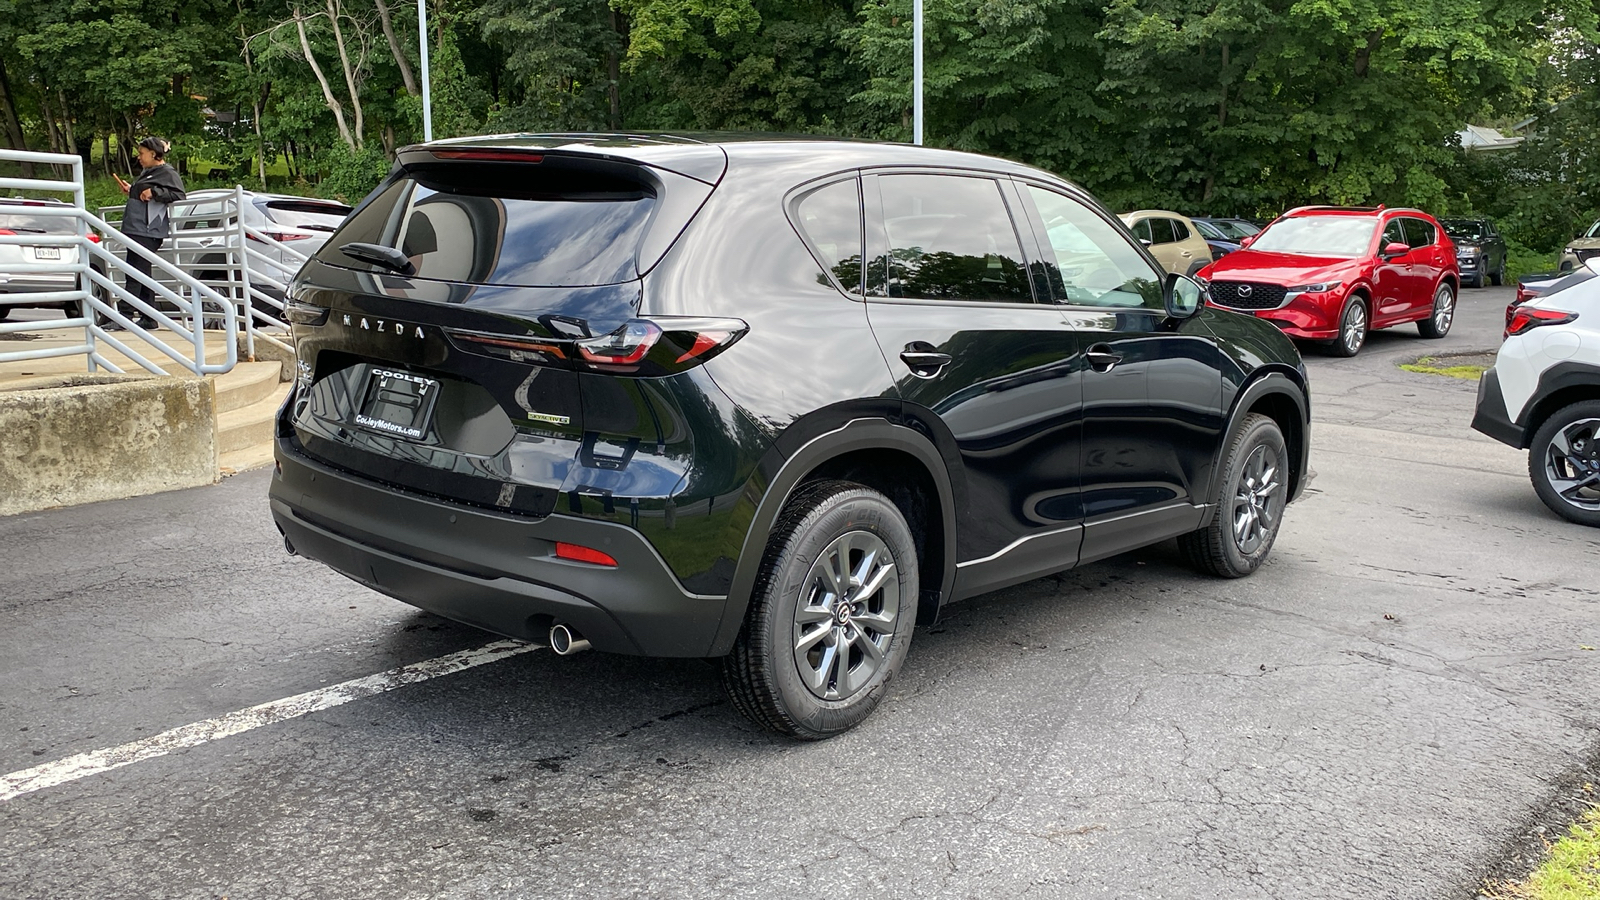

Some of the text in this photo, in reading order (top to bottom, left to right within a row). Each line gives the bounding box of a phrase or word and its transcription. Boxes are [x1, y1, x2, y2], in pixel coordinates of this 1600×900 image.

[343, 314, 425, 339] MAZDA
[372, 368, 436, 386] COOLEY
[355, 414, 421, 437] CooleyMotors.com
